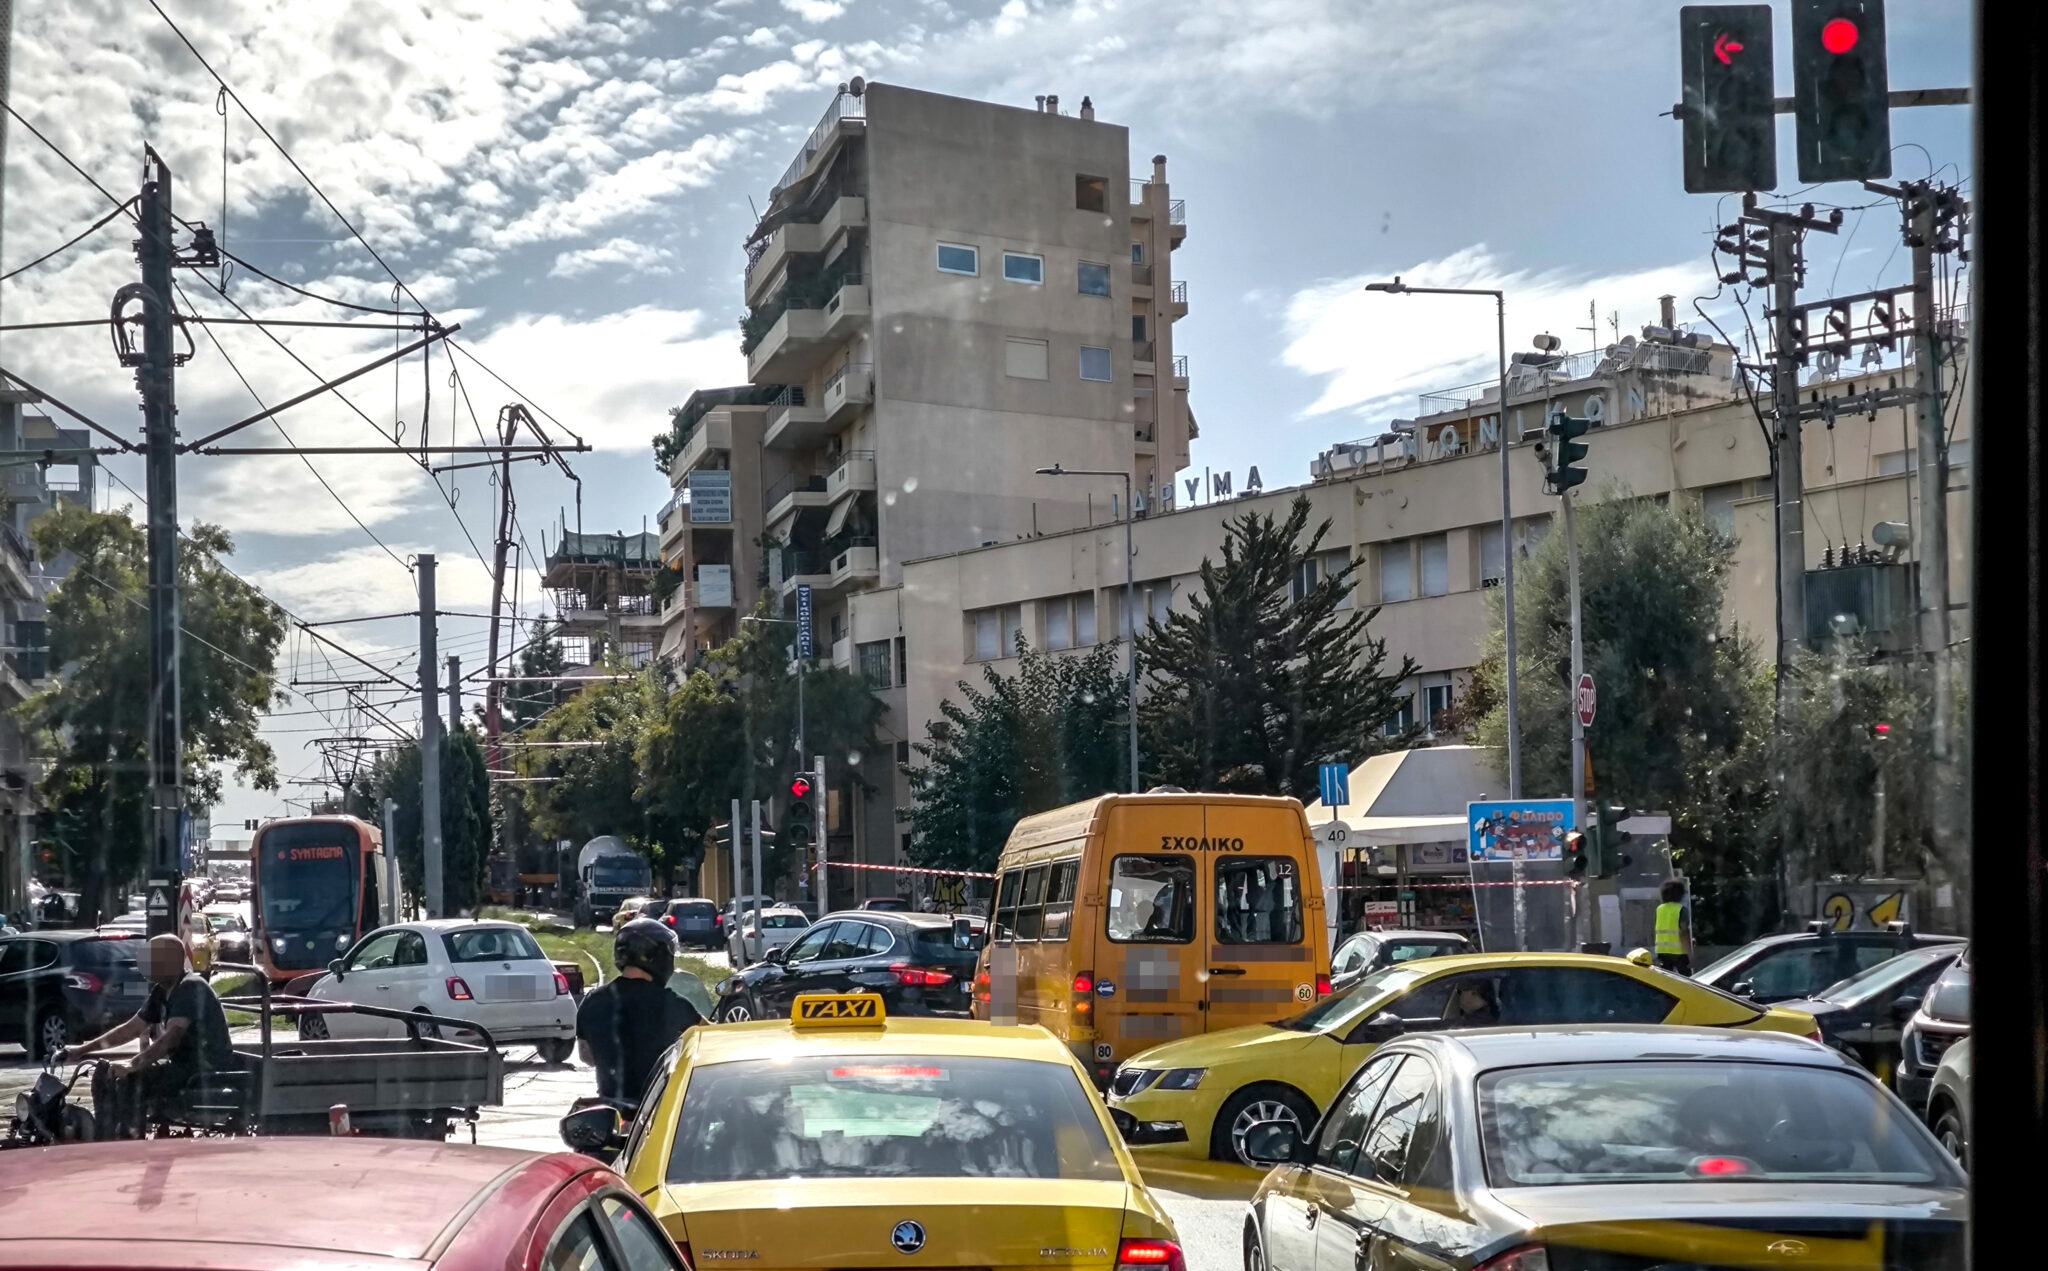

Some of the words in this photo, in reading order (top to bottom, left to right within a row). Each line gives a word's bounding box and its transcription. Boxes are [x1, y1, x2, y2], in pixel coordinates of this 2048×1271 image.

[1112, 465, 1263, 517] ΙΔΡΥΜΑ
[1579, 687, 1595, 714] STOP
[1328, 829, 1346, 842] 40
[1161, 836, 1244, 852] ΣΧΟΛΙΚΟ
[290, 846, 344, 861] SYNTAGMA
[1278, 864, 1293, 876] 12
[1298, 987, 1311, 1000] 60
[804, 1000, 872, 1018] TAXI
[1098, 1045, 1112, 1058] 80
